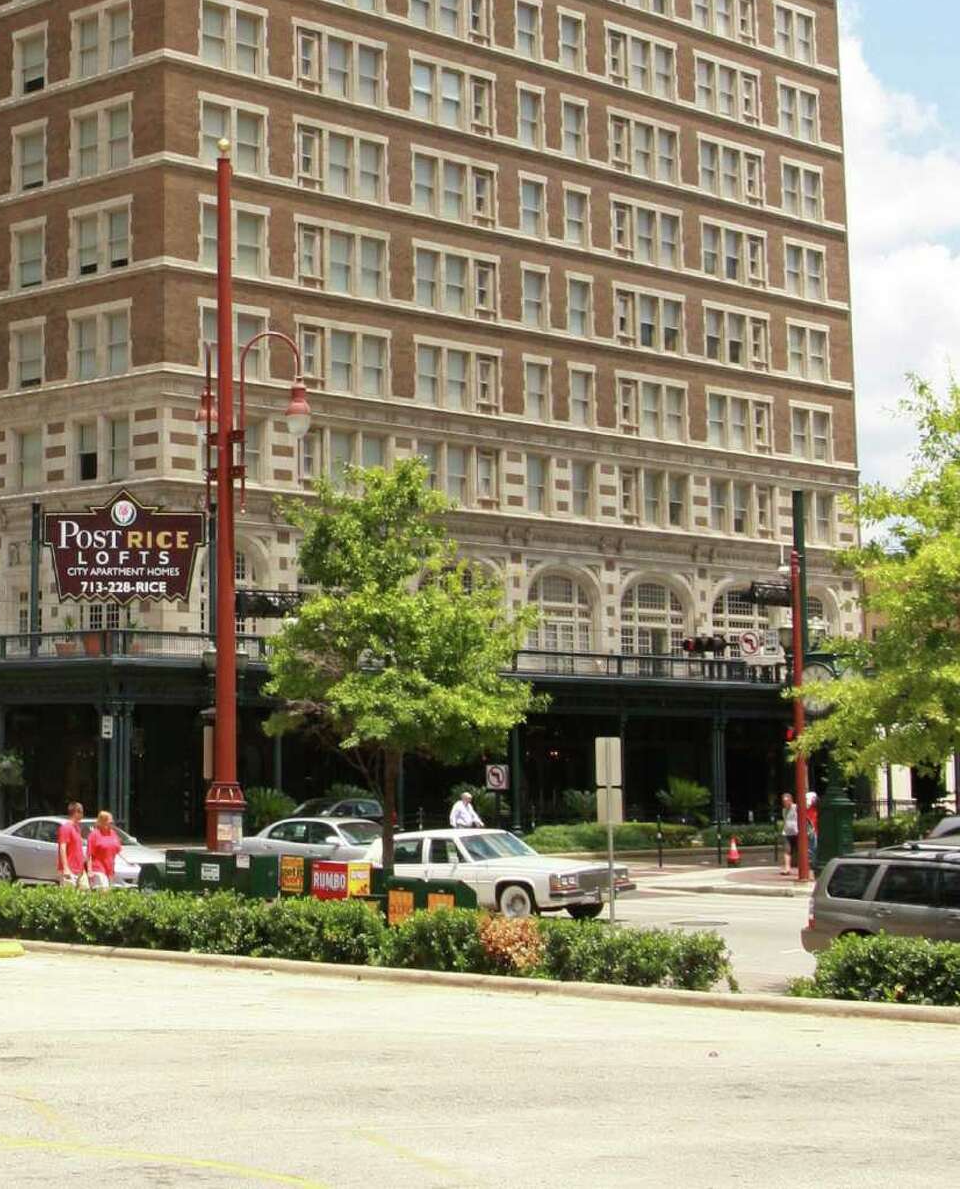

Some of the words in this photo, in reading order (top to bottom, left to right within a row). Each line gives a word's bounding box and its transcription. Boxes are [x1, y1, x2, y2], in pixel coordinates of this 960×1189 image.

[57, 520, 122, 549] POST
[127, 531, 189, 549] RICE
[78, 551, 170, 565] LOFTS
[67, 567, 89, 577] CITY
[90, 567, 145, 577] APARTMENT
[147, 567, 180, 577] HOMES
[81, 581, 167, 593] 713-228-RICE
[313, 871, 346, 892] RUMBO
